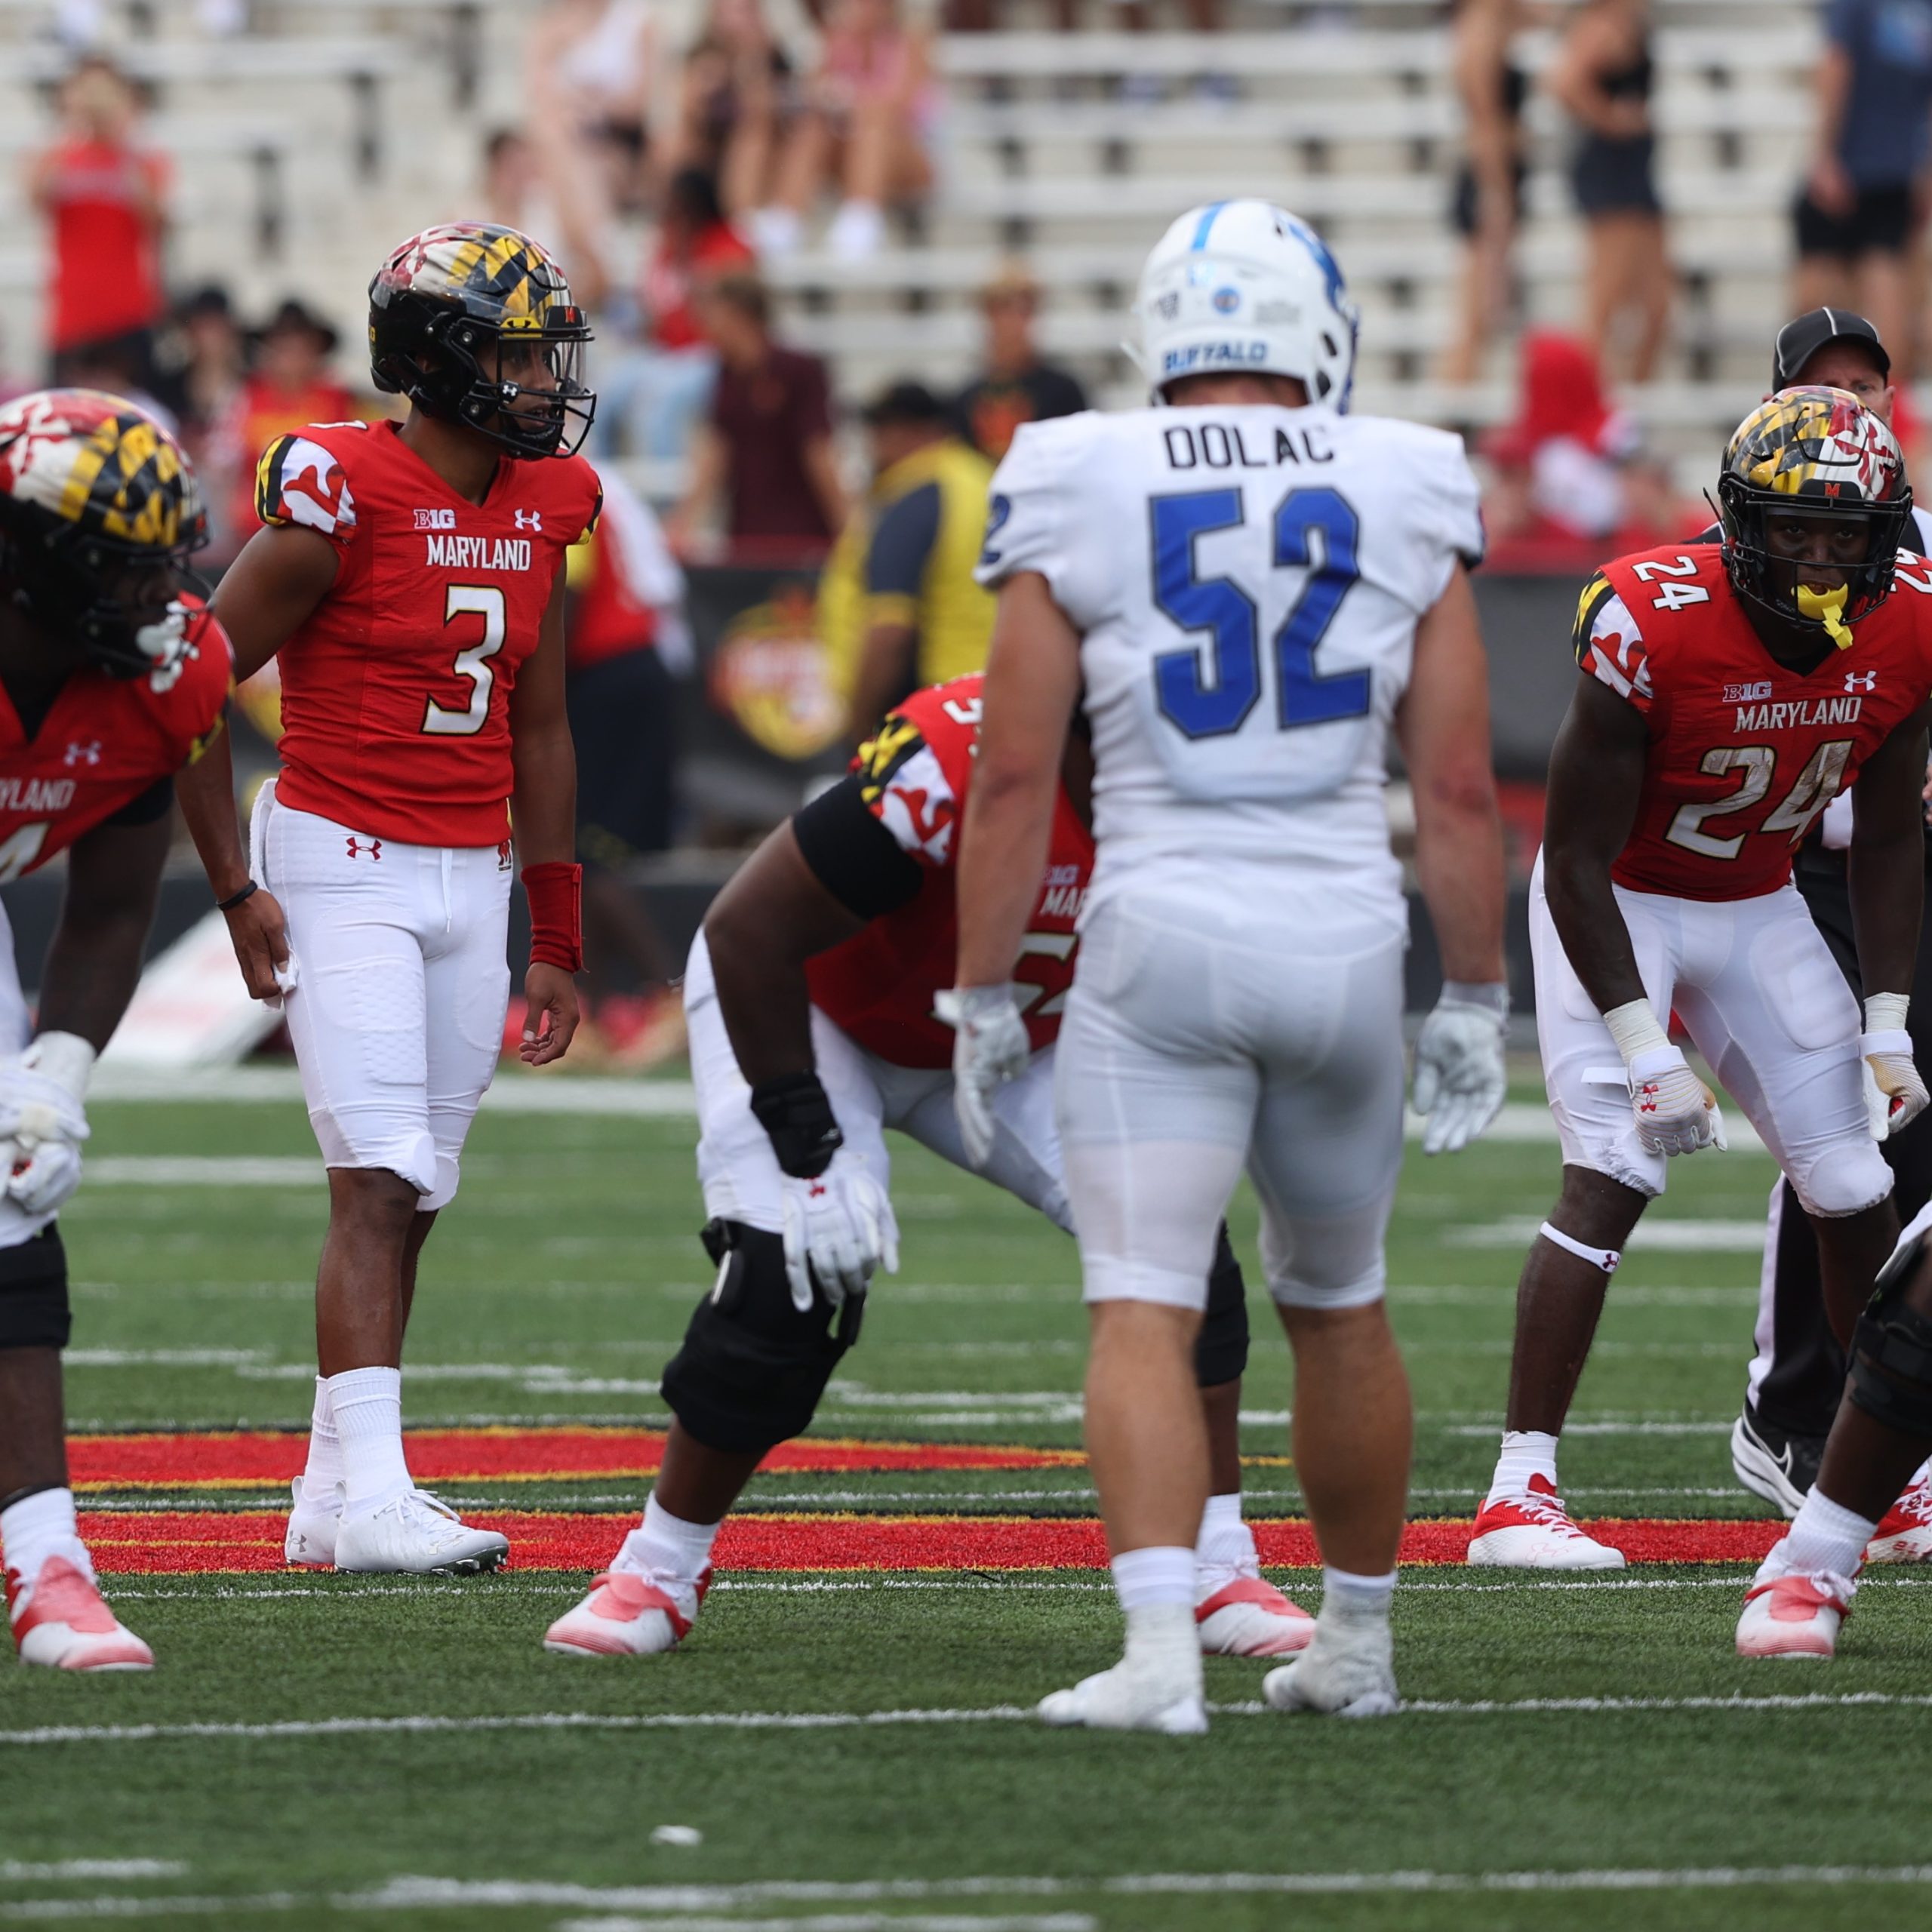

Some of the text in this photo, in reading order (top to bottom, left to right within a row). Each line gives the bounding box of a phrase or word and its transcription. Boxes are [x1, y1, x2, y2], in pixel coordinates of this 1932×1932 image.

[1165, 342, 1268, 371] BUFFALO
[1164, 423, 1334, 468] DOLAC
[426, 534, 531, 571] MARYLAND
[1632, 555, 1710, 611] 24
[1148, 485, 1371, 741] 52
[420, 583, 506, 737] 3
[1733, 696, 1862, 734] MARYLAND
[1660, 736, 1855, 860] 24
